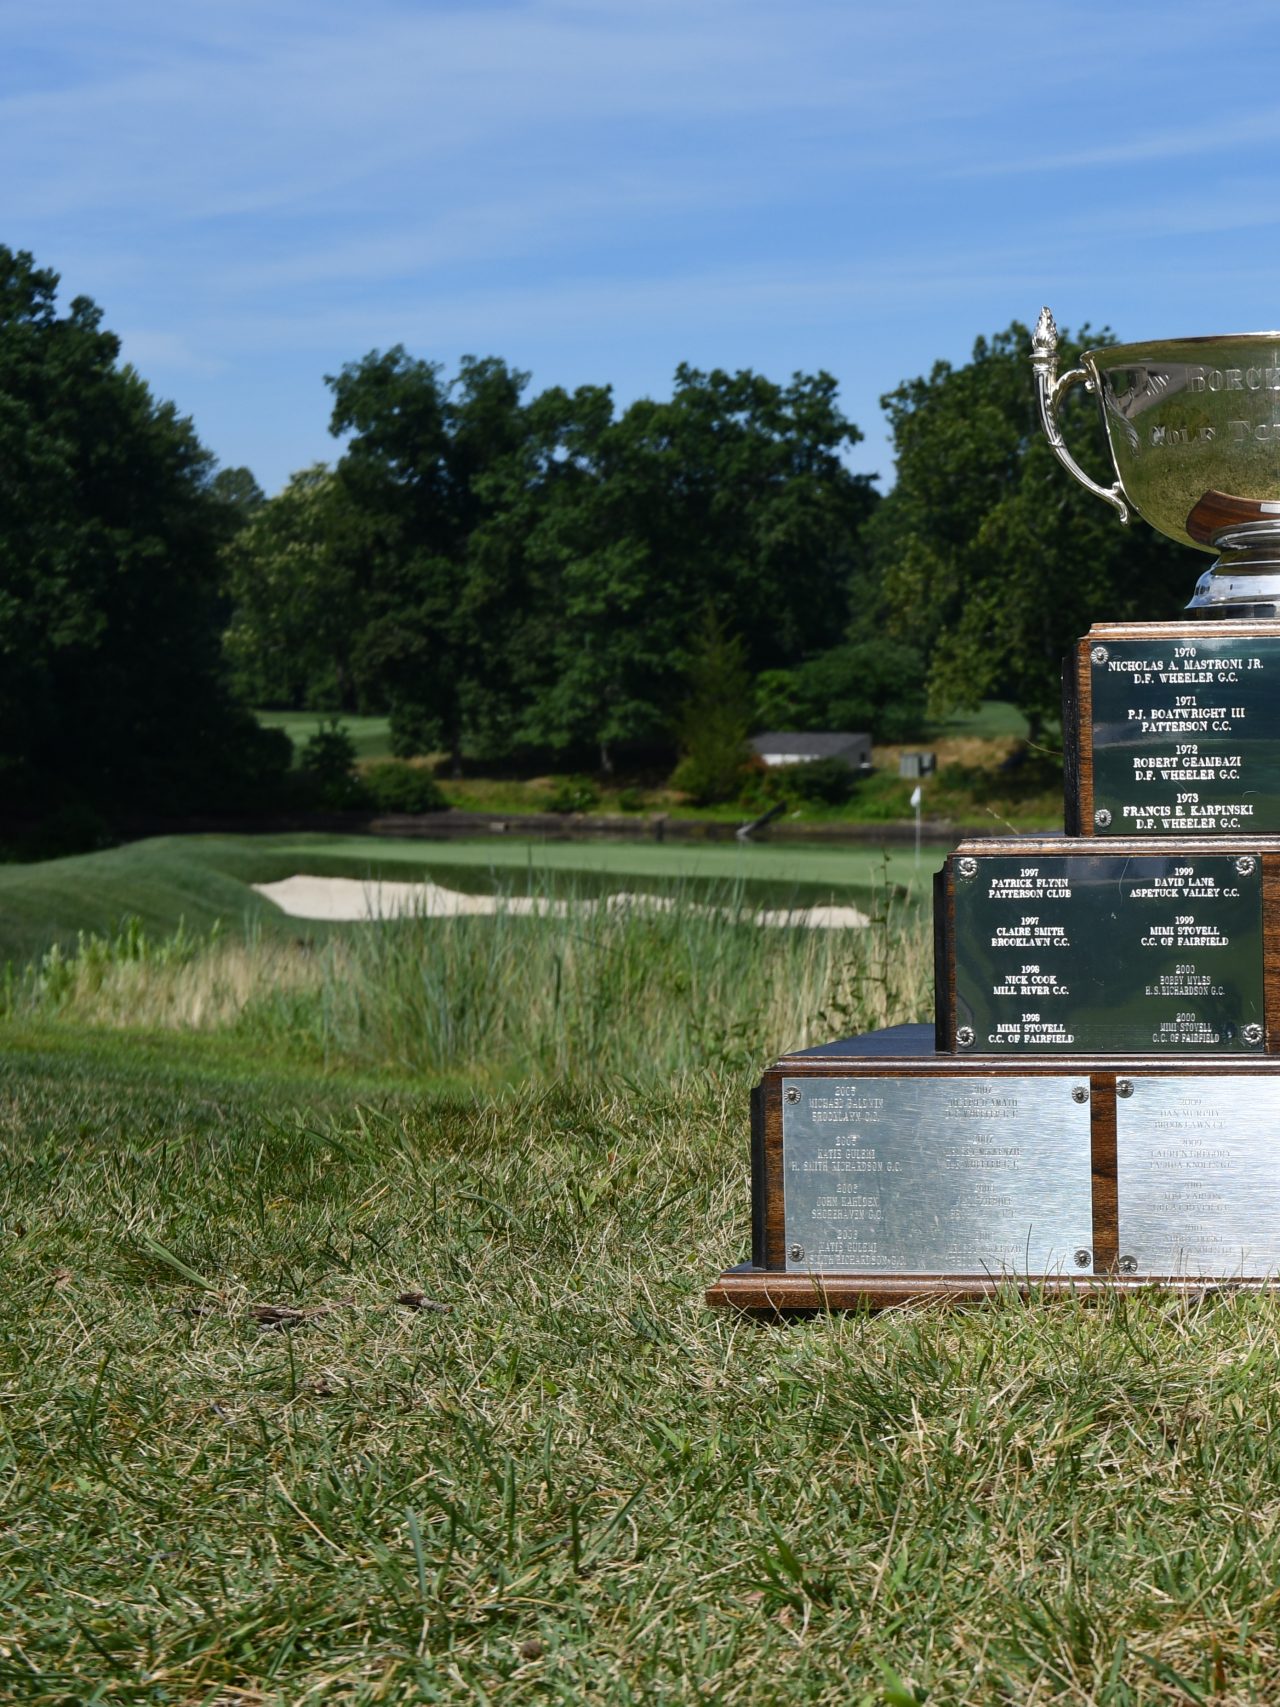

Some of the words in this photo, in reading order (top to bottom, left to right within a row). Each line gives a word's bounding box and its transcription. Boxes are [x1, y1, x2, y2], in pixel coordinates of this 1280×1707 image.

[1174, 648, 1196, 657] 1970
[1108, 661, 1163, 671] NICHOLAS
[1168, 661, 1178, 670] A.
[1184, 659, 1242, 670] MASTRONI
[1248, 659, 1263, 669] JR.
[1134, 674, 1154, 684] D.F.
[1159, 672, 1213, 683] WHEELER
[1218, 672, 1238, 682] G.C.
[1176, 696, 1196, 706] 1971
[1128, 710, 1146, 720] P.J.
[1151, 708, 1226, 719] BOATWRIGHT
[1232, 708, 1245, 718] III
[1142, 721, 1207, 732] PATTERSON
[1212, 721, 1231, 730] C.C.
[1176, 745, 1198, 754] 1972
[1133, 757, 1178, 768] ROBERT
[1182, 757, 1241, 767] GEAMBAZI
[1136, 770, 1156, 780] D.F.
[1161, 770, 1215, 780] WHEELER
[1219, 770, 1239, 779] G.C.
[1177, 793, 1198, 803] 1973
[1123, 806, 1170, 816] FRANCIS
[1176, 806, 1185, 816] E.
[1191, 805, 1253, 815] KARPINSKI
[1136, 819, 1156, 829] D.F.
[1162, 818, 1216, 828] WHEELER
[1220, 818, 1240, 828] G.C.
[1021, 869, 1039, 877] 1997
[1175, 867, 1193, 876] 1999
[992, 879, 1033, 887] PATRICK
[1036, 879, 1068, 887] FLYNN
[1154, 878, 1184, 886] DAVID
[1189, 878, 1214, 886] LANE
[989, 890, 1043, 898] PATTERSON
[1047, 889, 1071, 898] CLUB
[1130, 889, 1178, 897] ASPETUCK
[1183, 888, 1220, 897] VALLEY
[1223, 888, 1239, 896] C.C.
[1021, 917, 1039, 925] 1997
[1175, 916, 1194, 924] 1999
[997, 927, 1031, 936] CLAIRE
[1034, 927, 1064, 936] SMITH
[1150, 927, 1174, 935] MIMI
[1178, 926, 1220, 935] STOVELL
[992, 938, 1050, 946] BROOKLAWN
[1054, 938, 1070, 946] C.C.
[1141, 938, 1157, 946] C.C.
[1161, 937, 1174, 946] OF
[1178, 937, 1228, 946] FAIRFIELD
[1022, 965, 1040, 973] 1998
[1005, 976, 1028, 984] NICK
[1031, 976, 1057, 984] COOK
[994, 986, 1017, 994] MILL
[1021, 986, 1050, 995] RIVER
[1053, 986, 1069, 994] C.C.
[1022, 1014, 1040, 1022] 1998
[997, 1024, 1021, 1032] MIMI
[1024, 1024, 1066, 1032] STOVELL
[988, 1035, 1004, 1043] C.C.
[1008, 1034, 1020, 1043] OF
[1024, 1034, 1074, 1043] FAIRFIELD
